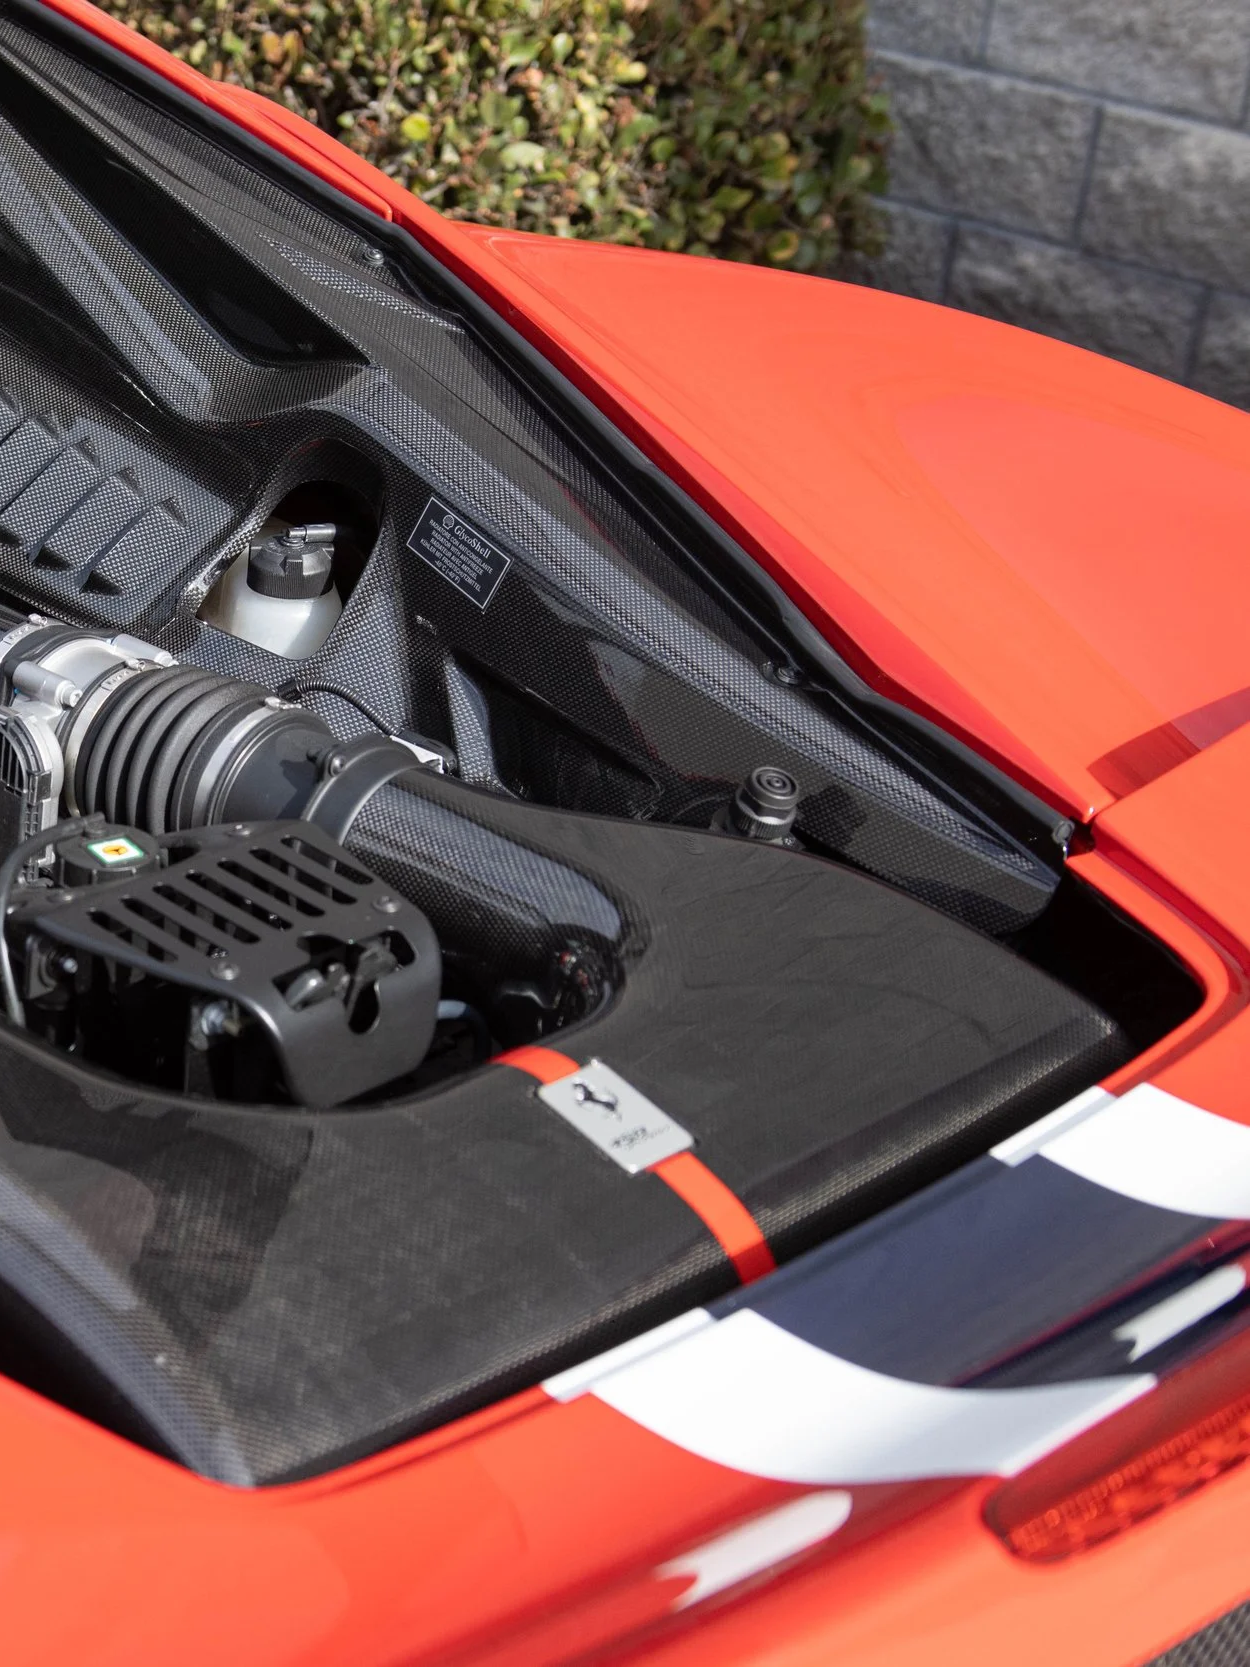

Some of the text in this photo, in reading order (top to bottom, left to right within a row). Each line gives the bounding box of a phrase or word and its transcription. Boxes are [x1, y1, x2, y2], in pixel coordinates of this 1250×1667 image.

[429, 519, 493, 574] RADIATORE CON ANTICONGELANTE
[429, 537, 478, 580] RADIATEUR AVEC ANTIGEL
[431, 529, 484, 576] RADIATOR WITH ANTIFREEZE
[435, 550, 443, 559] MIT
[454, 525, 491, 559] GlycoShell
